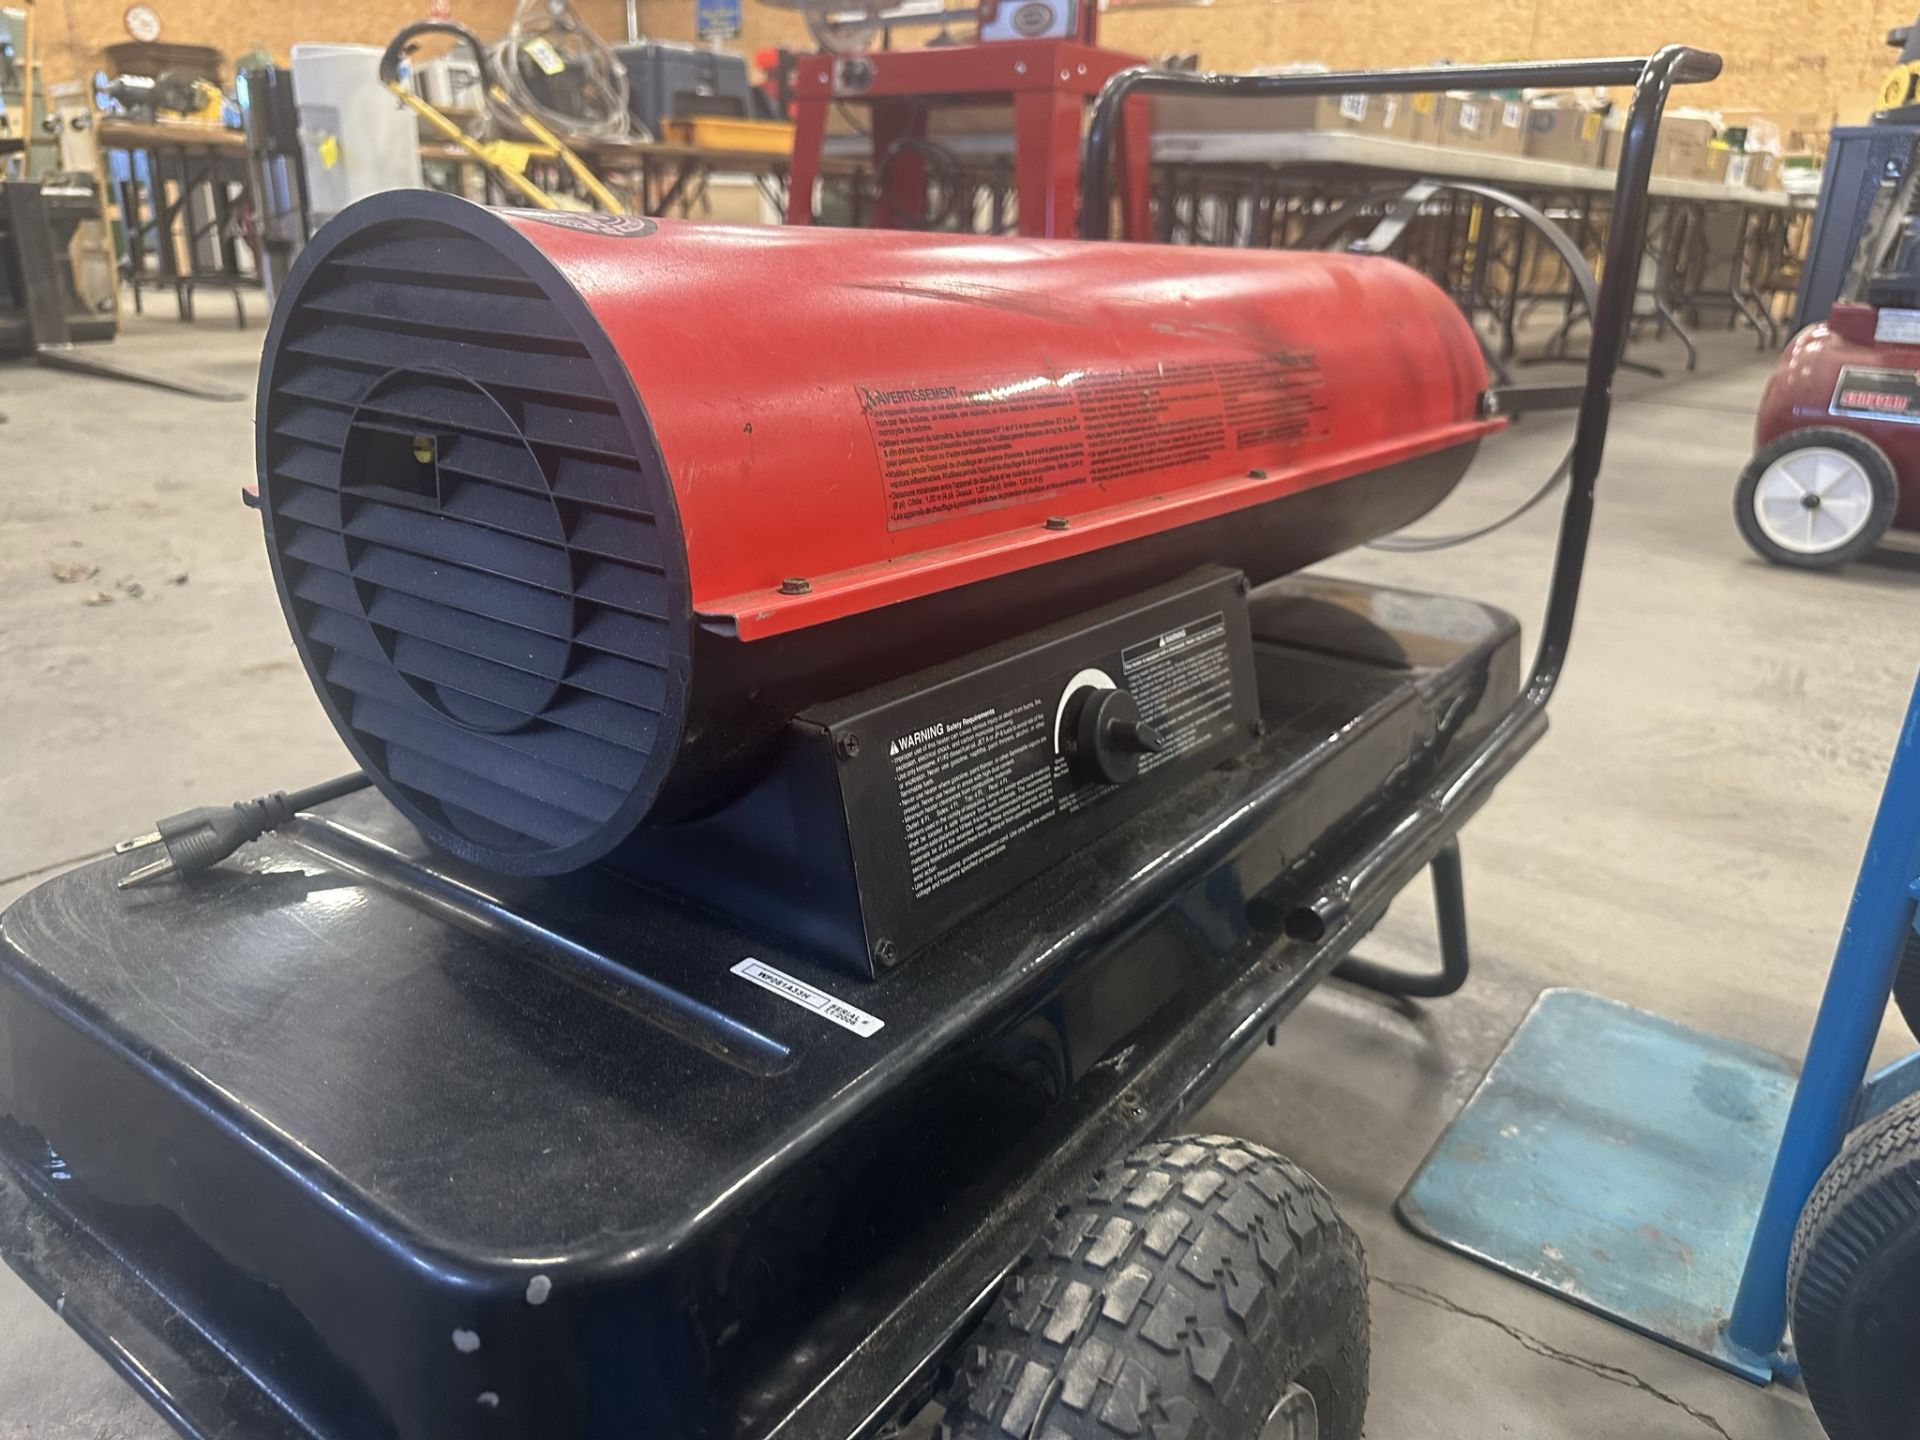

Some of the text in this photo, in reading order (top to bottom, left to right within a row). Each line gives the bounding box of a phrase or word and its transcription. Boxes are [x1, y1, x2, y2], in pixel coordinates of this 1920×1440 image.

[875, 386, 957, 405] AVERTISSEMENT
[898, 708, 995, 751] WARNING Safety Requirements
[829, 1003, 860, 1021] SERIAL
